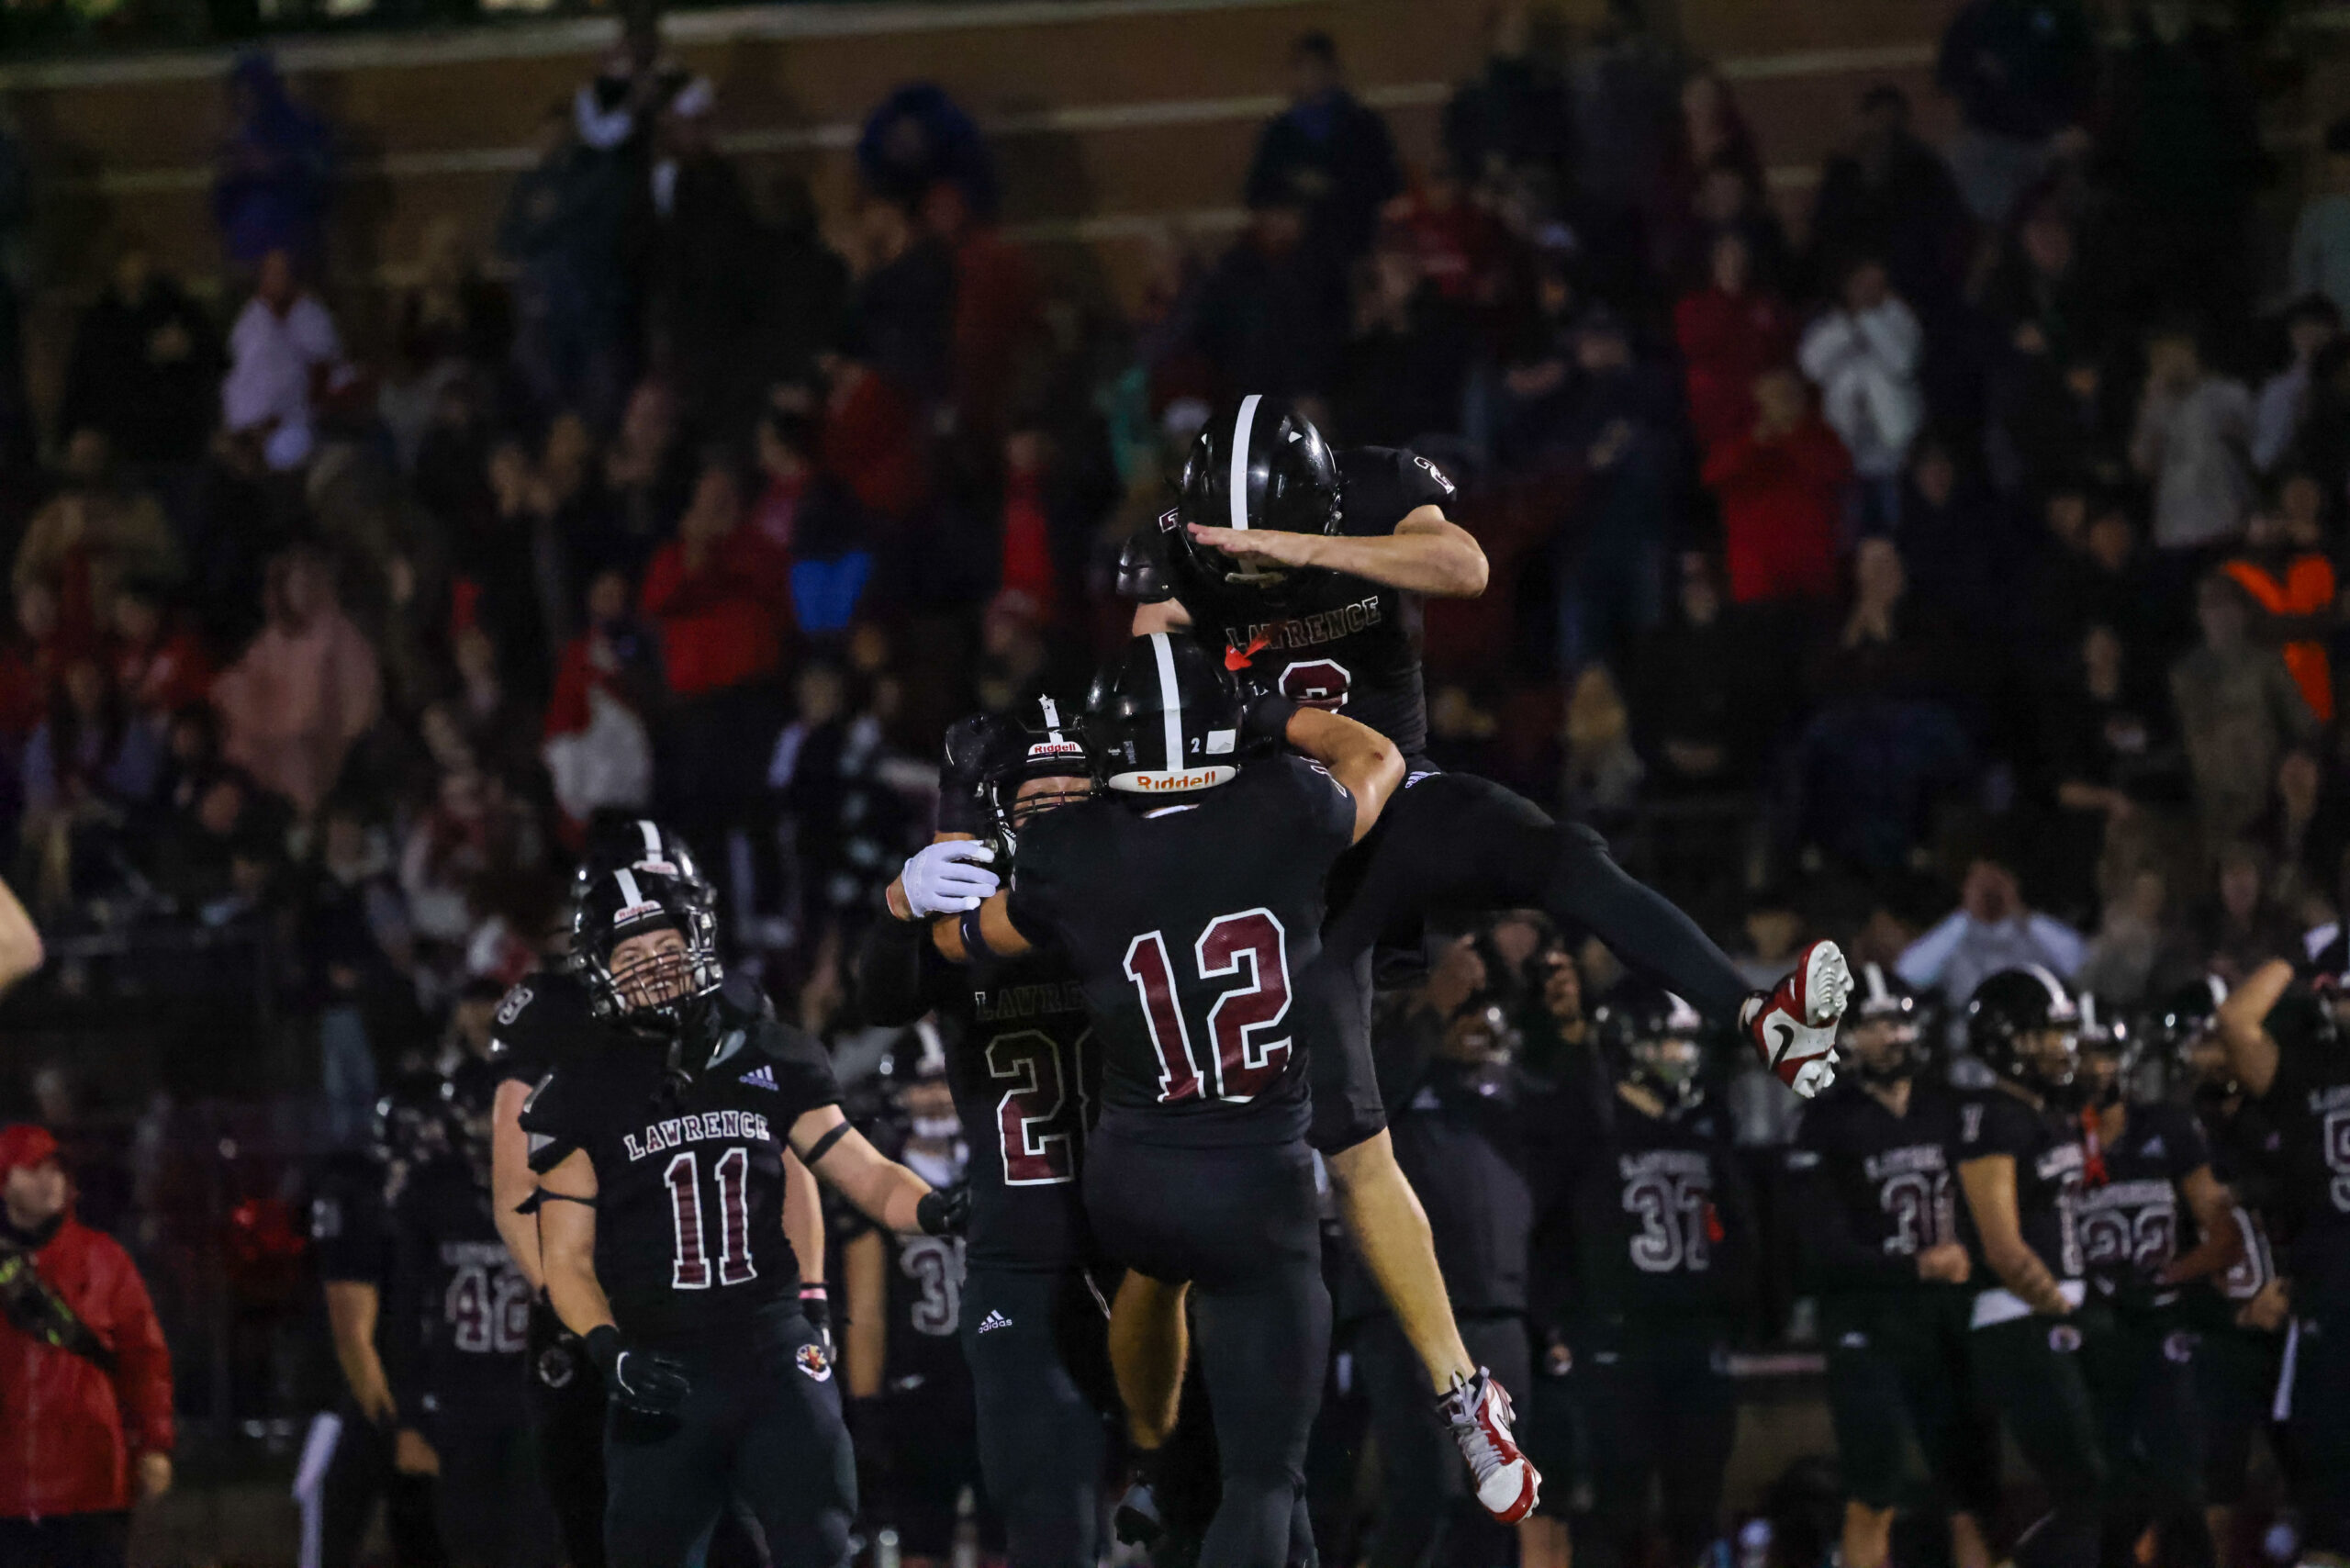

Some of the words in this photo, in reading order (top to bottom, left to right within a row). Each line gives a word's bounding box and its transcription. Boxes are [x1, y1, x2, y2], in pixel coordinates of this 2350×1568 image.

[1034, 743, 1077, 754] Riddell
[1191, 737, 1201, 754] 2
[1136, 770, 1216, 790] Riddell
[1122, 906, 1292, 1103] 12
[985, 1028, 1093, 1186] 2
[623, 1110, 771, 1162] LAWRENCE
[663, 1147, 759, 1290] 11
[899, 1236, 967, 1337] 3
[979, 1317, 1013, 1334] adidas
